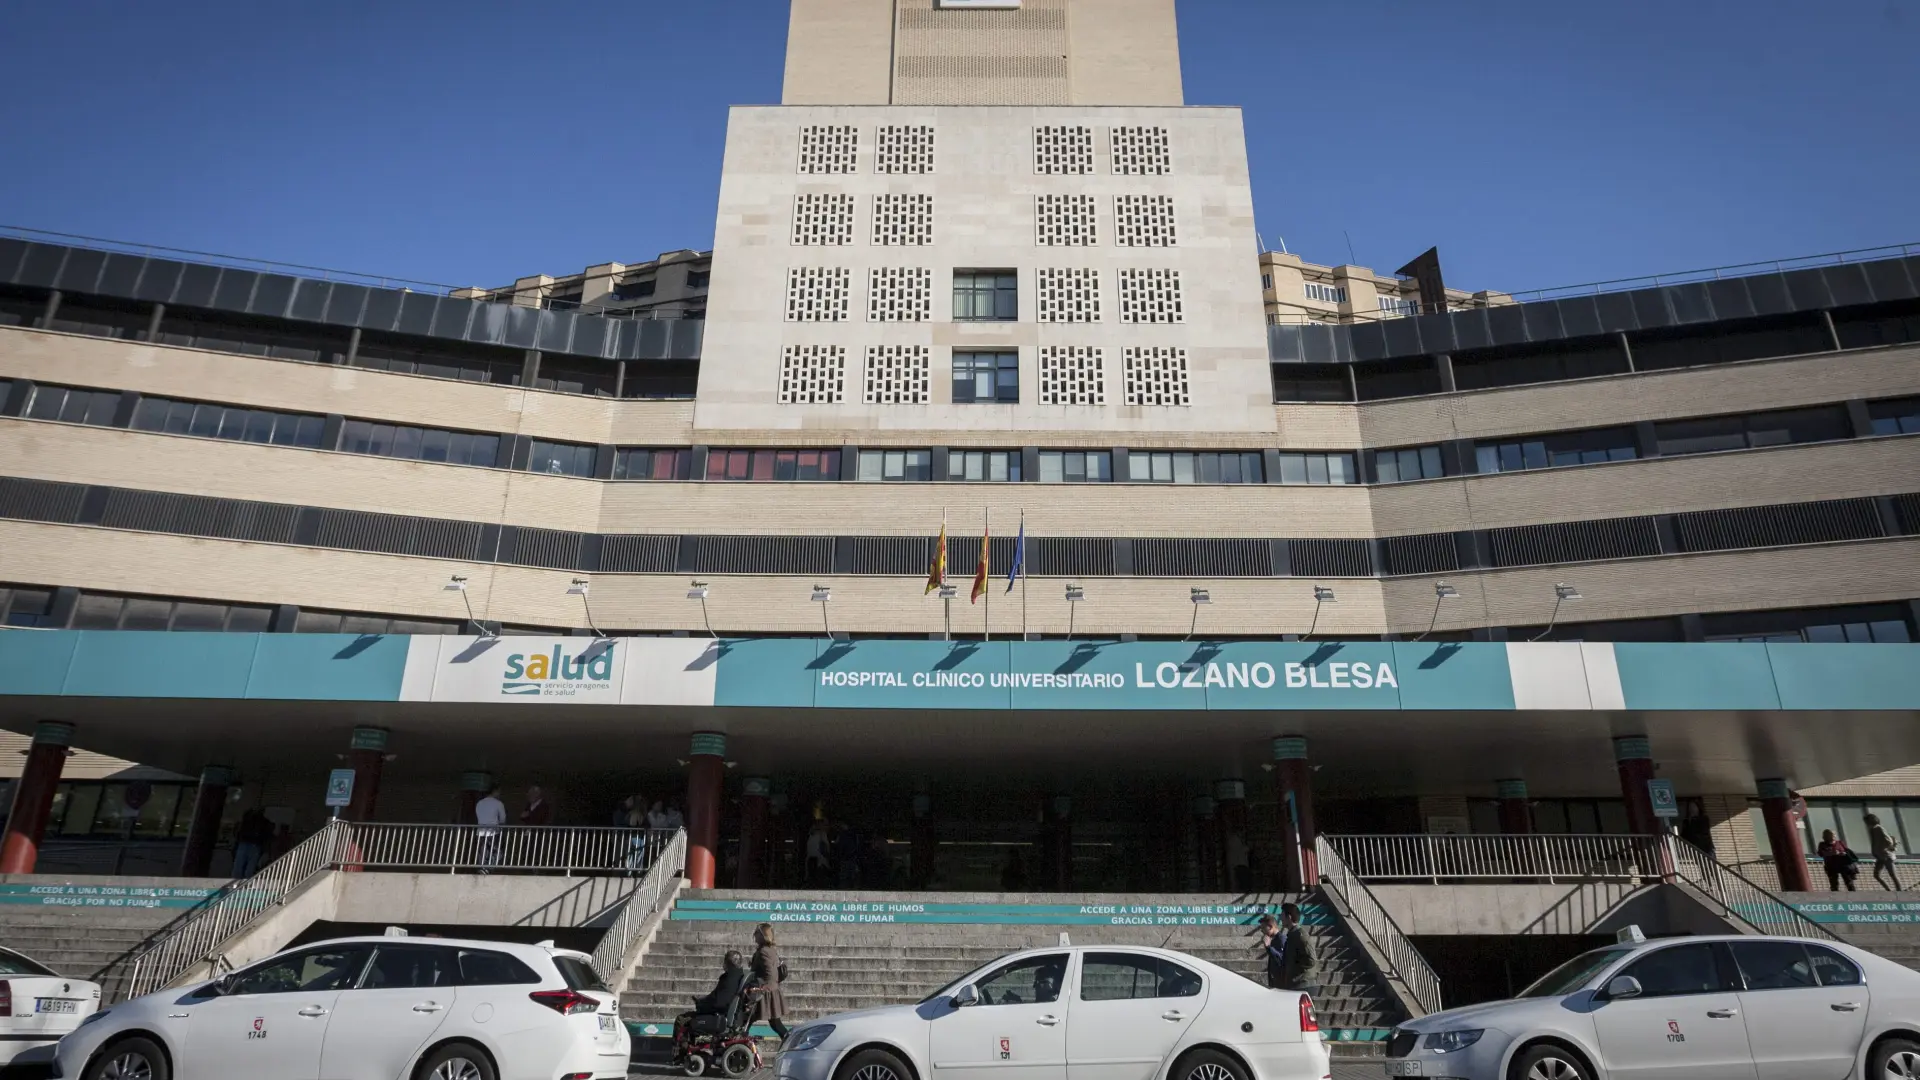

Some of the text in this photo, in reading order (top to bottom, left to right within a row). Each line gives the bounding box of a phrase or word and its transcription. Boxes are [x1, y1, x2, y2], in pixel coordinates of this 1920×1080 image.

[504, 644, 614, 680] salud
[821, 662, 1398, 688] HOSPITAL CLÍNICO UNIVERSITARIO LOZANO BLESA
[30, 886, 63, 894] ACCEDE
[78, 887, 97, 895] UNA
[130, 888, 155, 896] LIBRE
[173, 889, 208, 897] HUMOS
[43, 897, 82, 905] GRACIAS
[109, 898, 123, 906] NO
[735, 902, 925, 912] ACCEDE A UNA ZONA LIBRE DE HUMOS
[1080, 906, 1116, 914] ACCEDE
[1120, 906, 1127, 914] A
[1131, 906, 1151, 914] UNA
[1156, 906, 1184, 914] ZONA
[1188, 906, 1213, 914] LIBRE
[1217, 906, 1229, 914] DE
[1800, 904, 1833, 912] ACCEDE
[1872, 903, 1897, 911] ZONA
[769, 913, 895, 923] GRACIAS POR NO FUMAR
[1111, 917, 1236, 925] GRACIAS POR NO FUMAR
[1847, 914, 1888, 922] GRACIAS
[1892, 914, 1912, 922] POR
[42, 1001, 60, 1012] 4819
[248, 1031, 267, 1039] 1748
[1667, 1033, 1685, 1042] 1708
[1000, 1051, 1010, 1060] 131
[1405, 1062, 1419, 1075] SP
